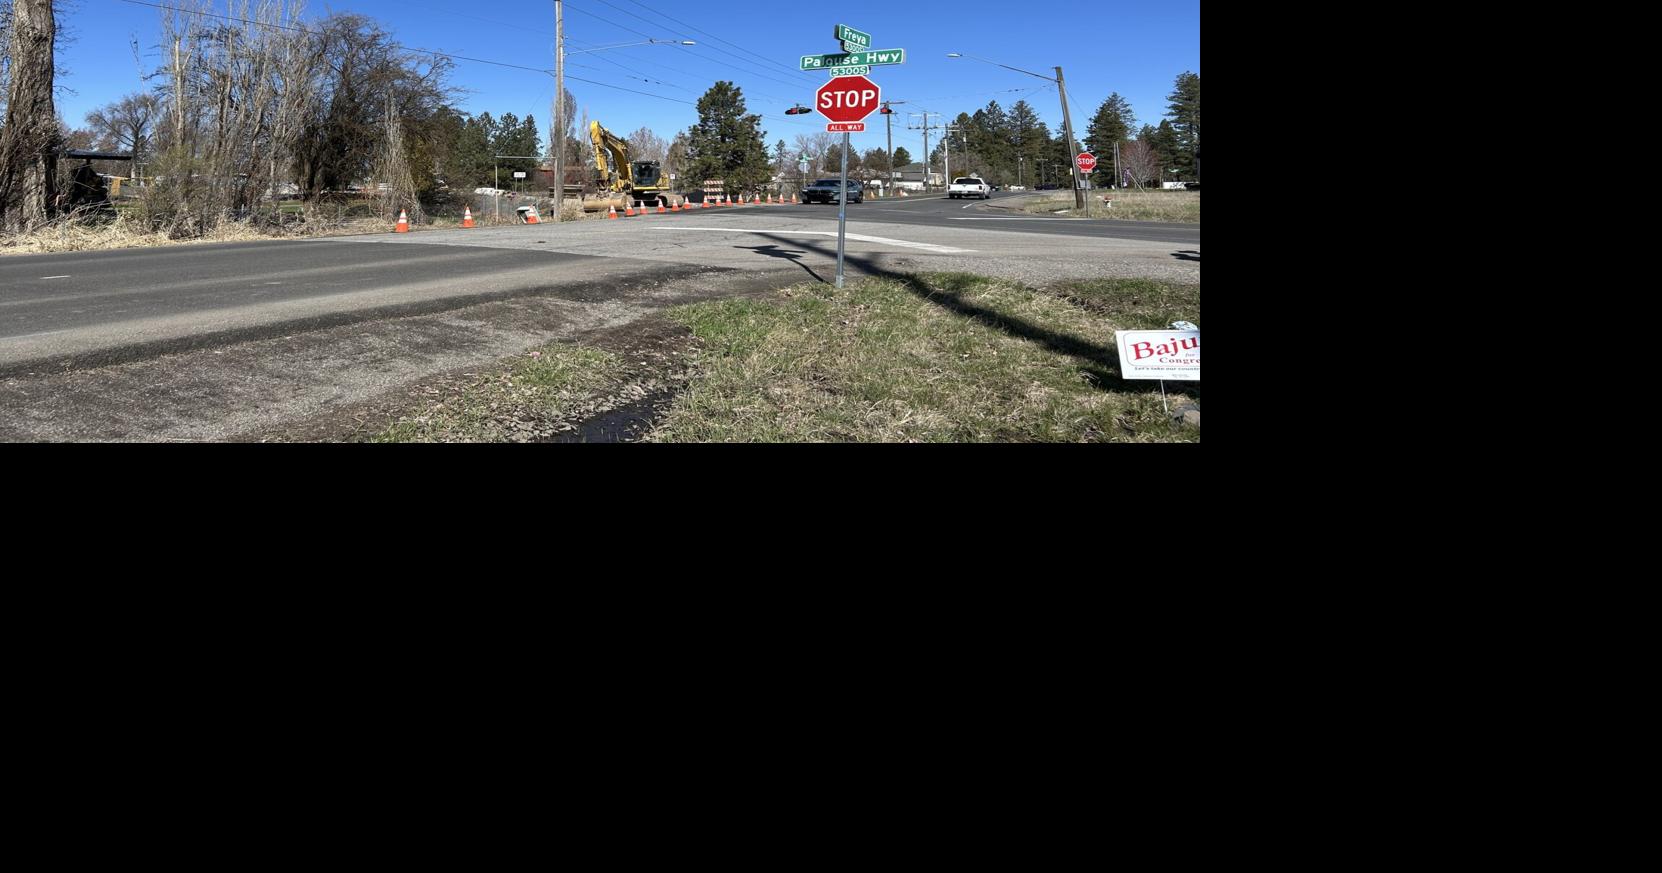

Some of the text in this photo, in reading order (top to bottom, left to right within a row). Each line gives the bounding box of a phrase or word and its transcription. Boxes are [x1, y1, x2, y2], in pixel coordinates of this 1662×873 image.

[844, 27, 866, 45] Freya
[804, 52, 900, 67] Palouse Hwy
[832, 66, 866, 75] 5300S
[820, 90, 875, 108] STOP
